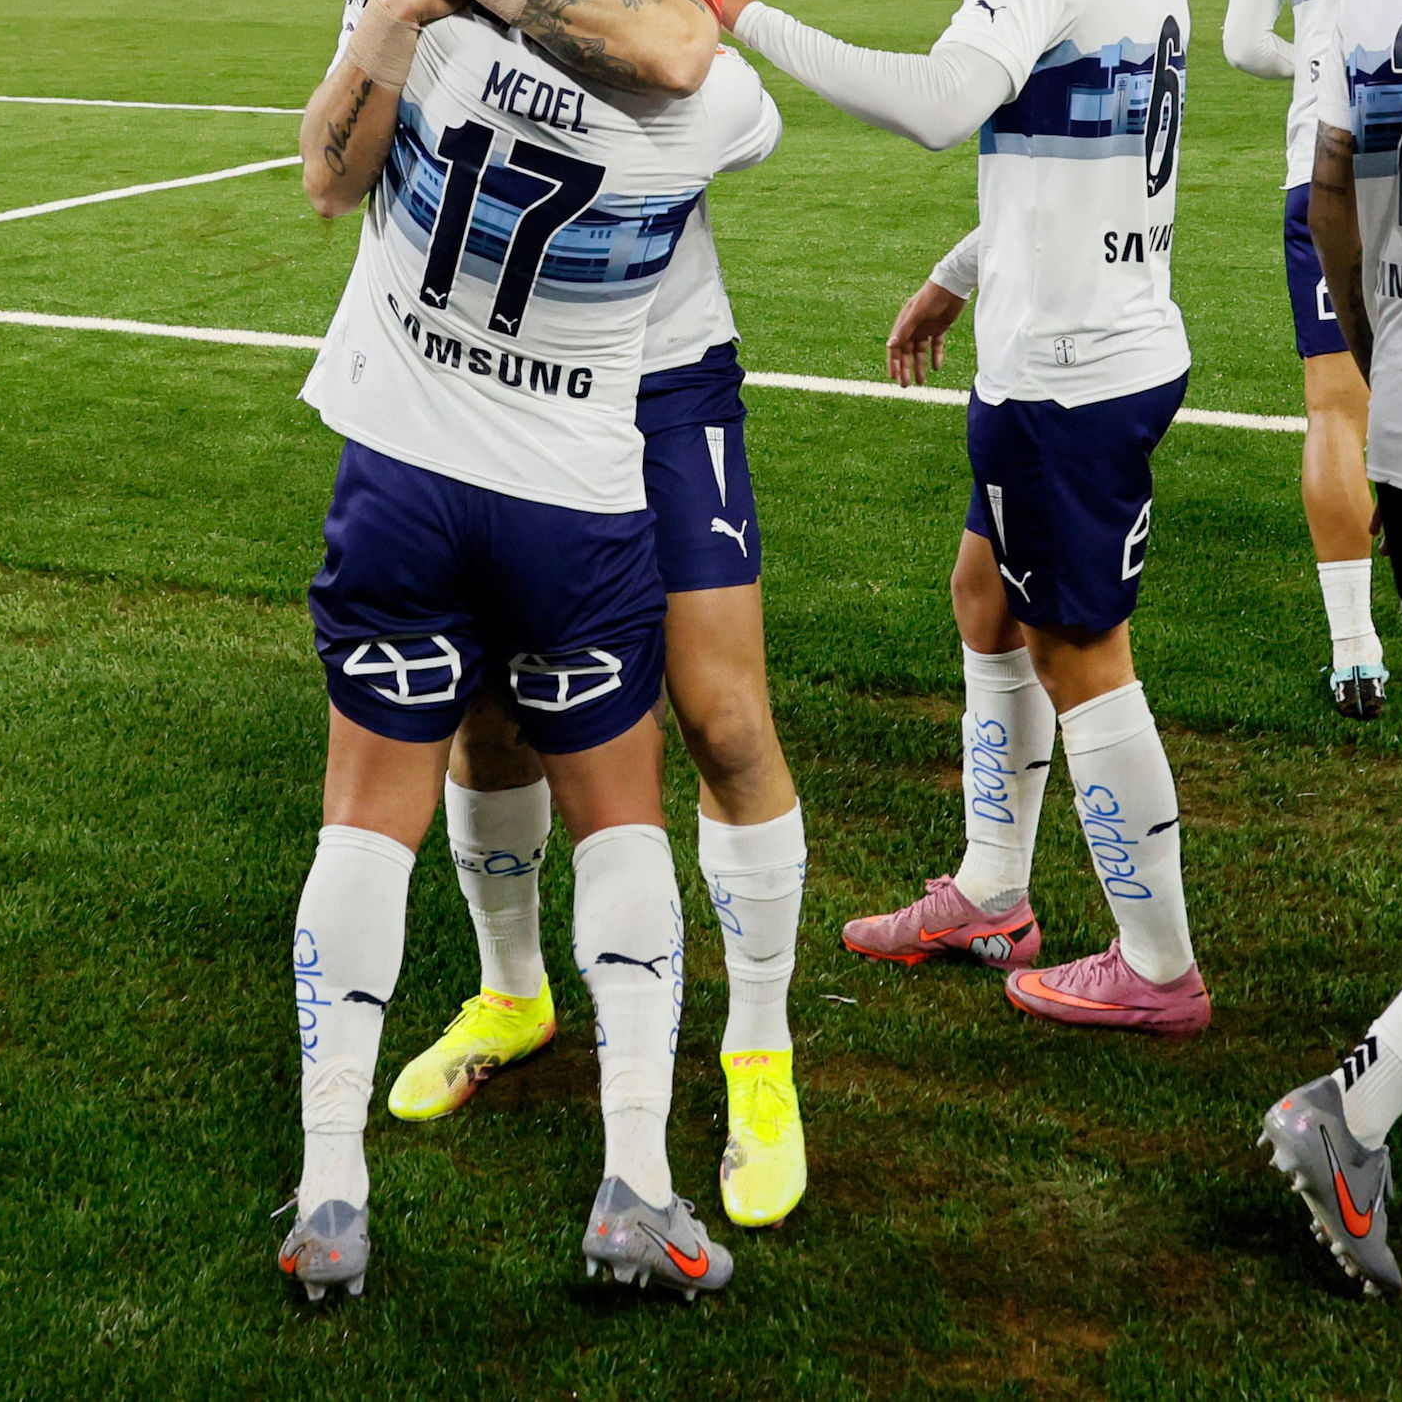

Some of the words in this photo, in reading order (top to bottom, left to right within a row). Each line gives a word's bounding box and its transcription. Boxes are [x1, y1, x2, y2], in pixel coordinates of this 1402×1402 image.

[481, 60, 589, 135] MEDEL
[1145, 14, 1183, 199] 6
[434, 117, 607, 339] 17
